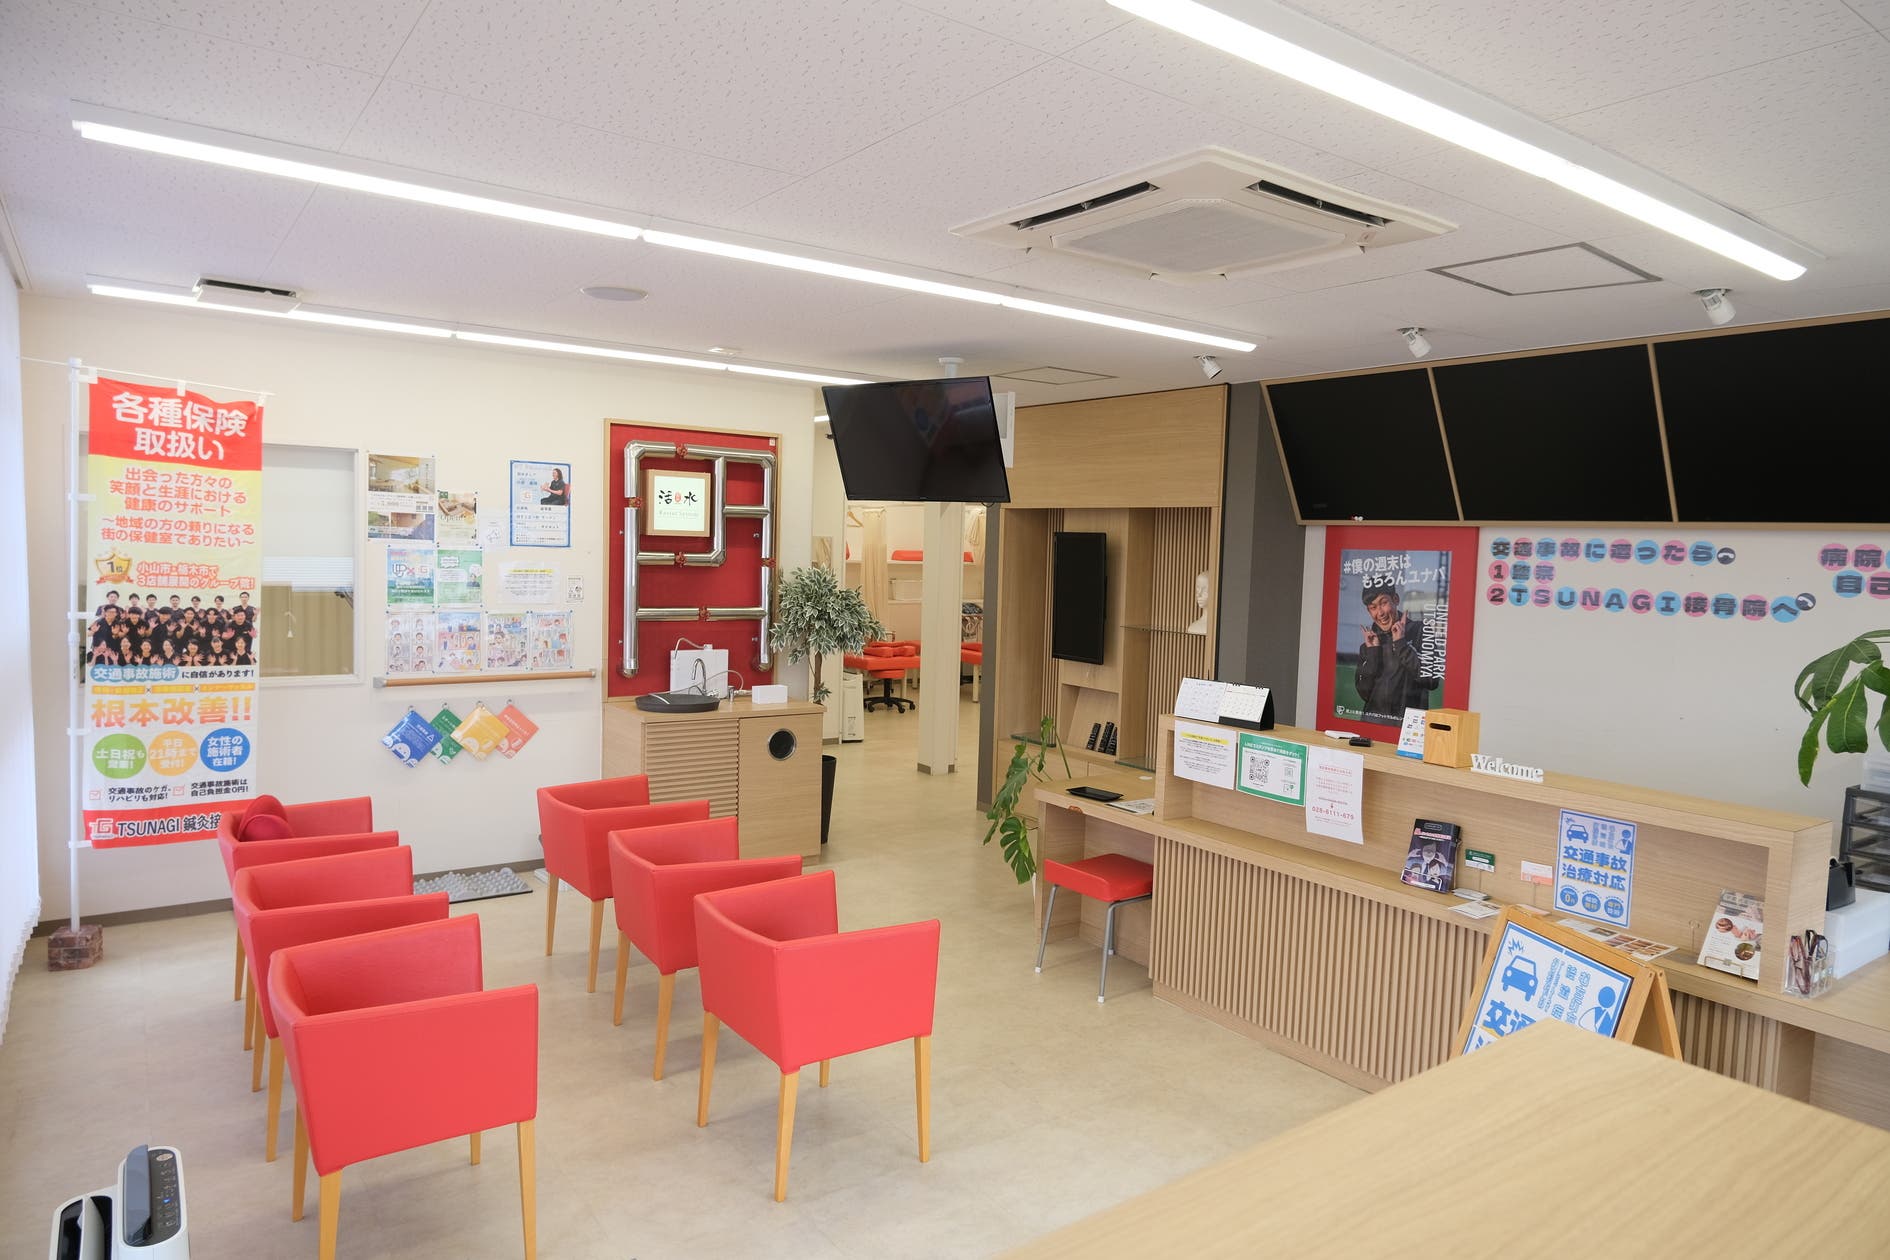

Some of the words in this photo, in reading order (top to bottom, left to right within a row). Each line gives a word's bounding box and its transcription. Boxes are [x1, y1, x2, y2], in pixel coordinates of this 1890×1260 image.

[111, 391, 249, 438] 各種保険
[133, 427, 225, 461] 取扱い
[124, 467, 233, 490] 出会った方々の
[109, 479, 248, 505] 笑顔と生涯における
[123, 496, 232, 518] 健康のサポート
[1343, 553, 1412, 575] #僕の週末は
[1434, 603, 1449, 645] UNITED
[1419, 603, 1437, 679] UTSUNOMIYA
[92, 666, 177, 682] 交通事故施術
[181, 669, 254, 681] に自信があります!
[1432, 647, 1447, 680] PARK
[91, 696, 252, 728] 根本改善!!
[207, 735, 243, 747] 女性の
[207, 746, 244, 758] 施術者
[95, 748, 145, 760] 土日祝も
[1471, 754, 1544, 782] Welcome
[191, 778, 248, 789] 交通事故施術は
[108, 792, 169, 803] リハビリも対応!
[117, 818, 180, 838] TSUNAGI
[1563, 845, 1628, 873] 交通事故
[1561, 863, 1627, 892] 治療対応
